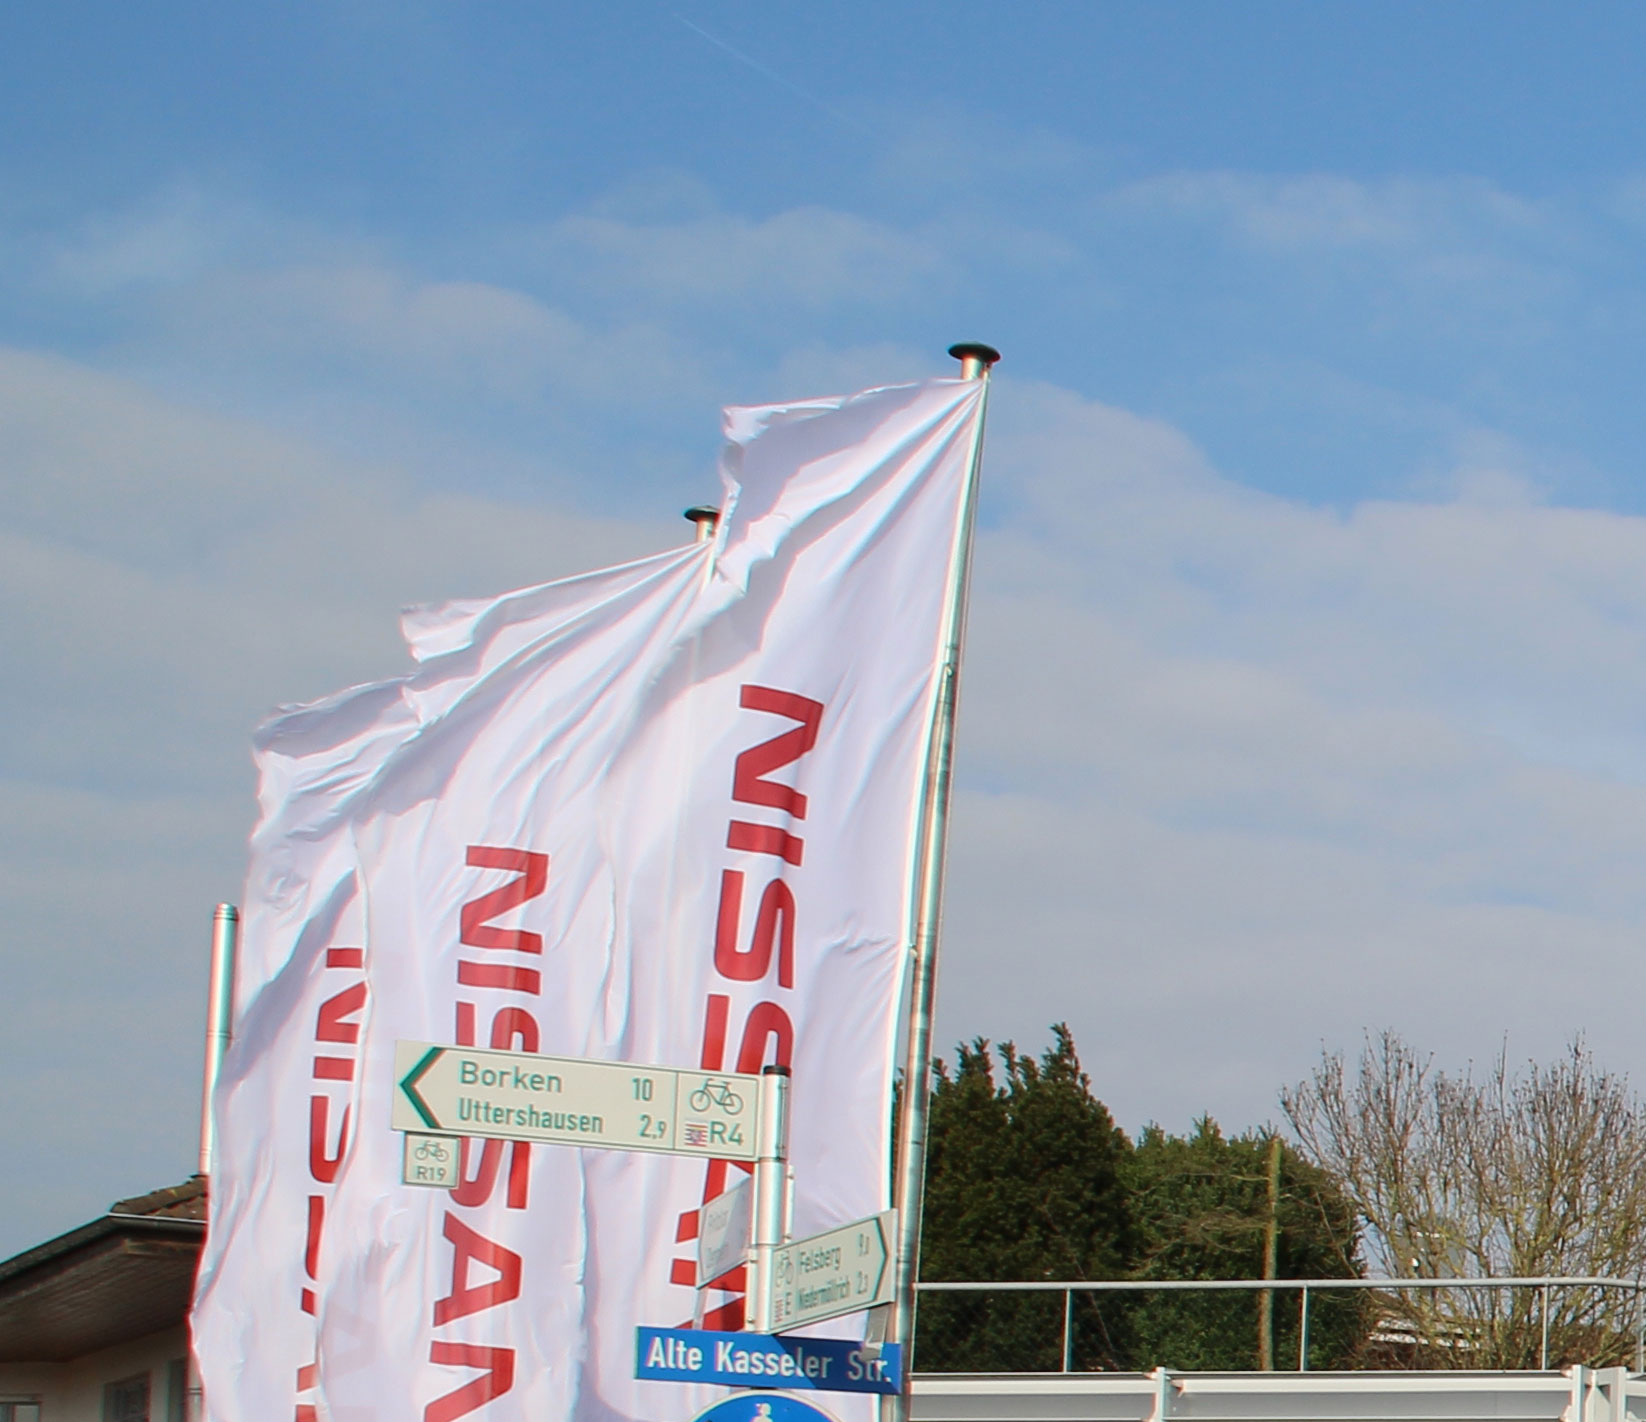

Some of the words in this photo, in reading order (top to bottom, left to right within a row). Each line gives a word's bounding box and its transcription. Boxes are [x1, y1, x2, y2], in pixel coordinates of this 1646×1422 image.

[459, 1059, 562, 1093] Borken
[632, 1077, 653, 1101] 10
[458, 1097, 603, 1134] Uttershausen
[709, 1121, 745, 1146] R4
[416, 1165, 447, 1181] R19
[646, 1336, 703, 1370] Alte
[716, 1341, 833, 1379] Kasseler
[849, 1350, 892, 1383] Str.
